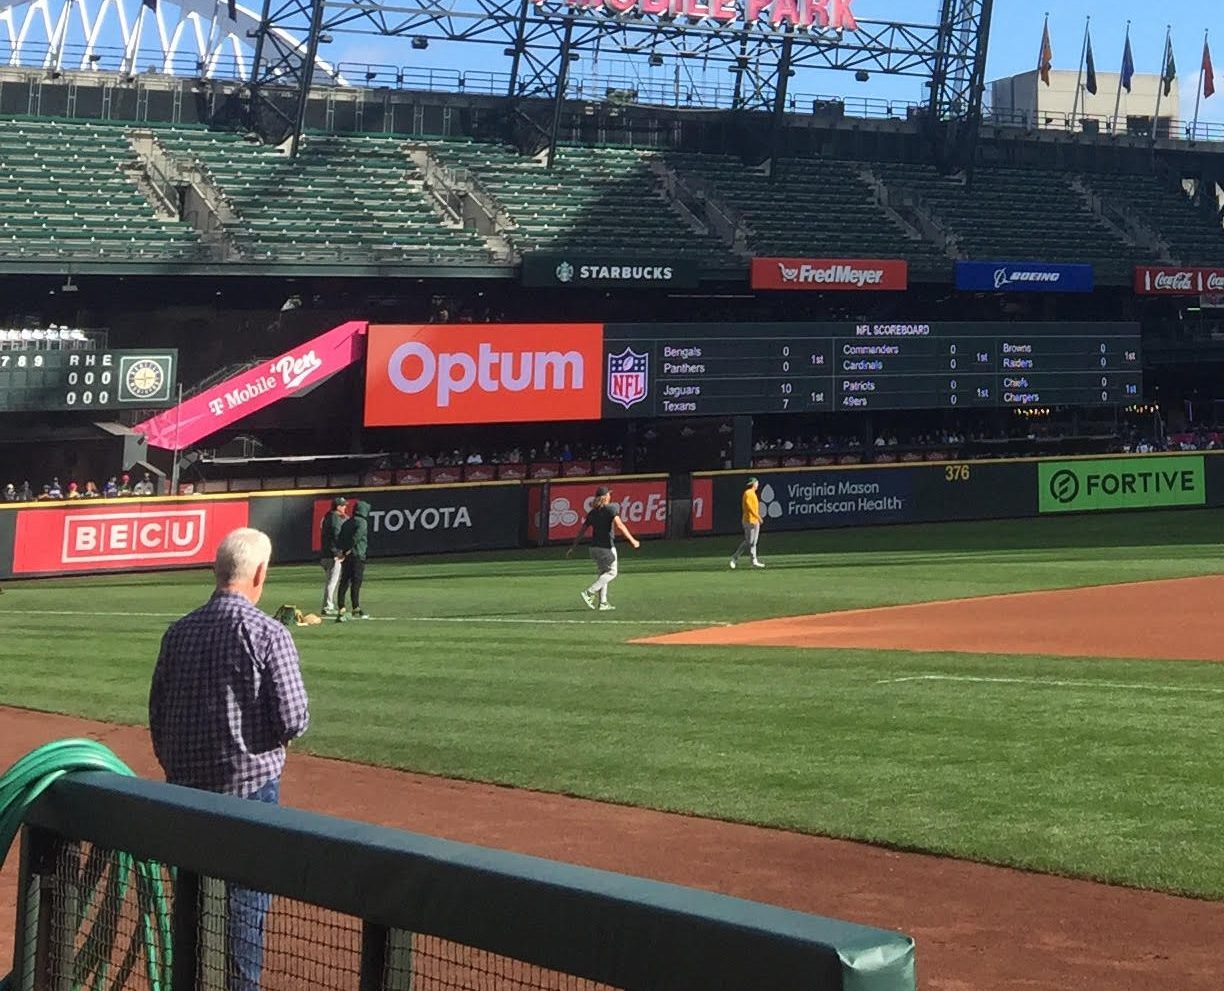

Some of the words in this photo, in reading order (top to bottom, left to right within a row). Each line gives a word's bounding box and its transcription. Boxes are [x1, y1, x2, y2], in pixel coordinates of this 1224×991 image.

[579, 265, 673, 280] STARBUCKS
[1009, 271, 1060, 283] BOEING
[856, 325, 872, 336] NFL
[873, 324, 930, 336] SCOREBOARD
[664, 346, 702, 359] Bengals
[782, 346, 790, 356] 0
[843, 344, 899, 355] Commanders
[950, 344, 956, 354] 0
[1003, 343, 1032, 353] Browns
[1, 355, 10, 367] 7
[17, 355, 27, 367] 8
[34, 355, 43, 367] 9
[69, 354, 79, 366] R
[85, 354, 96, 366] H
[102, 354, 113, 366] E
[810, 354, 825, 365] 1st
[976, 352, 988, 362] 1st
[664, 362, 706, 374] Panthers
[782, 361, 790, 372] 0
[843, 360, 883, 370] Cardinals
[950, 359, 956, 369] 0
[68, 372, 78, 385] 0
[84, 372, 94, 385] 0
[101, 371, 111, 384] 0
[224, 376, 277, 409] Mobile
[270, 349, 322, 390] Pen
[387, 341, 585, 407] Optum
[613, 374, 644, 399] NFL
[663, 385, 701, 398] Jaguars
[780, 383, 792, 394] 10
[843, 380, 876, 391] Patriots
[66, 391, 76, 405] 0
[82, 391, 92, 404] 0
[99, 391, 109, 404] 0
[811, 392, 825, 402] 1st
[976, 388, 989, 398] 1st
[1003, 392, 1040, 404] Chargers
[663, 400, 697, 411] Texans
[782, 398, 790, 408] 7
[843, 396, 868, 406] 49ers
[950, 395, 957, 405] 0
[945, 465, 970, 481] 376
[1086, 470, 1195, 496] FORTIVE
[787, 481, 836, 500] Virginia
[838, 480, 880, 496] Mason
[787, 498, 856, 515] Franciscan
[858, 496, 902, 512] Health
[368, 506, 473, 533] TOYOTA
